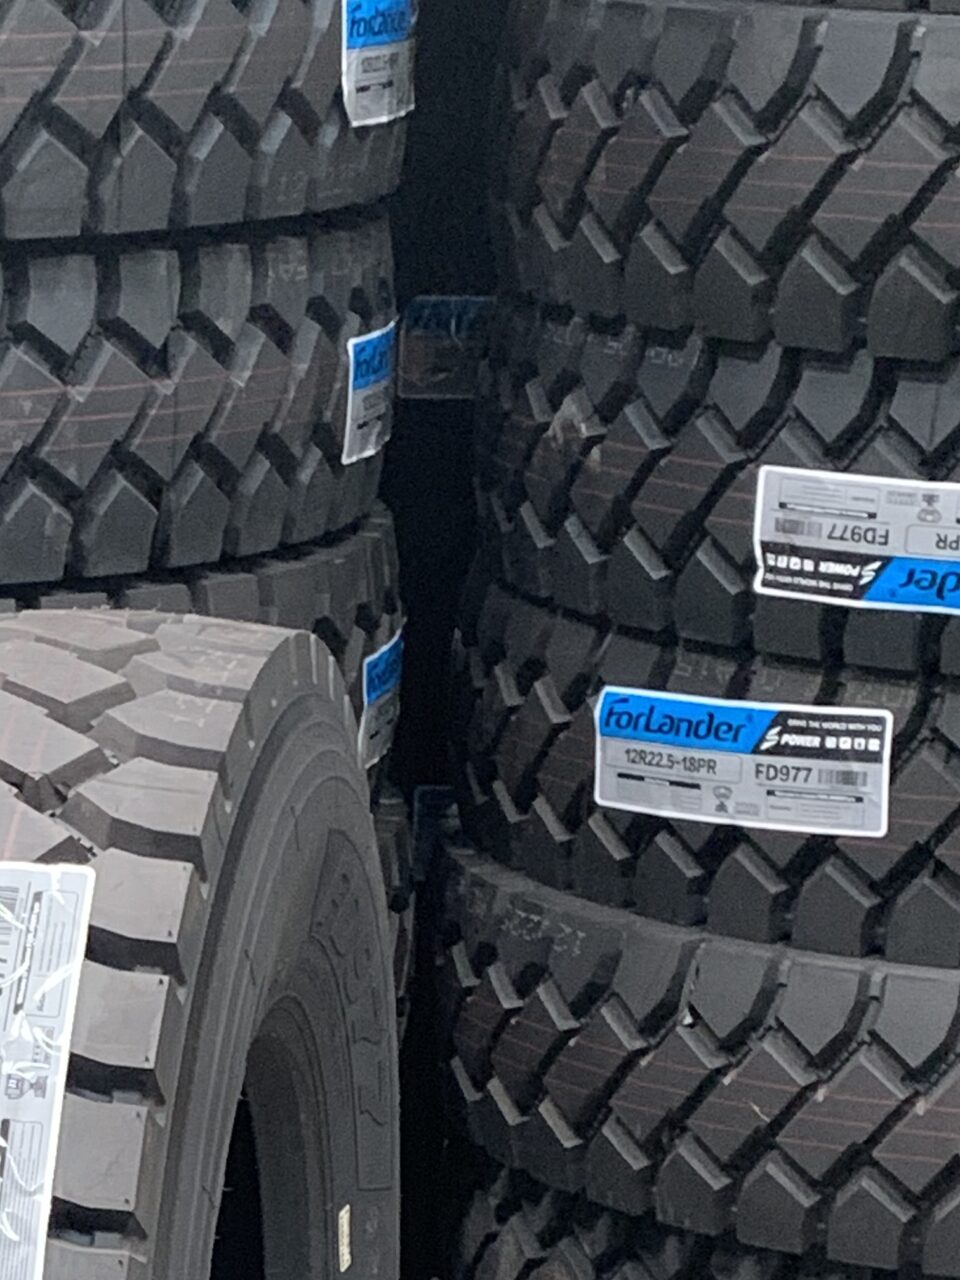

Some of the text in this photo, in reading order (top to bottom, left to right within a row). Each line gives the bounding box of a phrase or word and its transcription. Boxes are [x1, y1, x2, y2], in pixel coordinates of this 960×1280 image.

[826, 523, 890, 546] FD977
[604, 696, 746, 744] ForLander
[624, 747, 717, 776] 12R22.5-18PR
[755, 762, 814, 784] FD977
